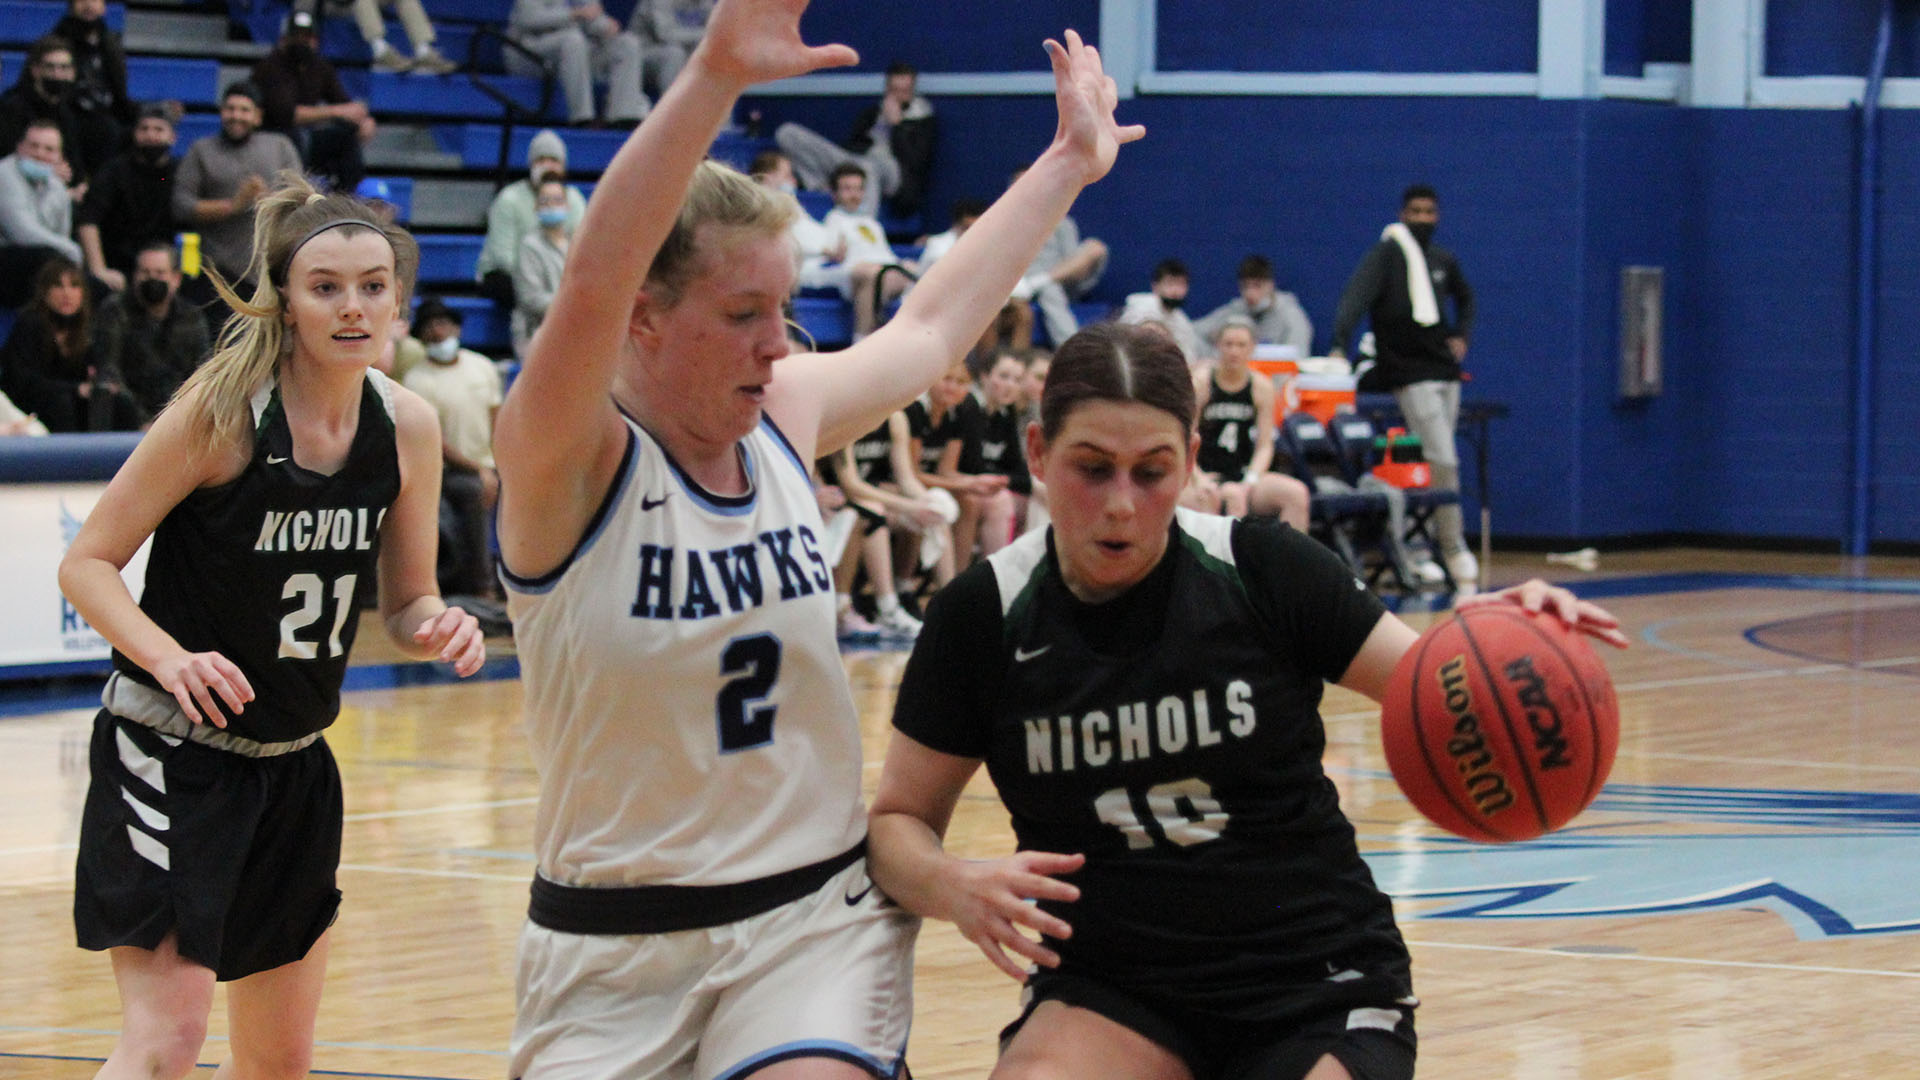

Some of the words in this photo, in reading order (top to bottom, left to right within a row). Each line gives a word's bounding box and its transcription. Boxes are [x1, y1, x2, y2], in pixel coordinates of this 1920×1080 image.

[1217, 422, 1238, 452] 4
[278, 573, 357, 659] 21
[630, 525, 830, 620] HAWKS
[716, 630, 783, 756] 2
[1024, 679, 1256, 774] NICHOLS
[1436, 653, 1516, 818] Wilson
[1504, 655, 1573, 772] NCAA
[1094, 777, 1230, 850] 10
